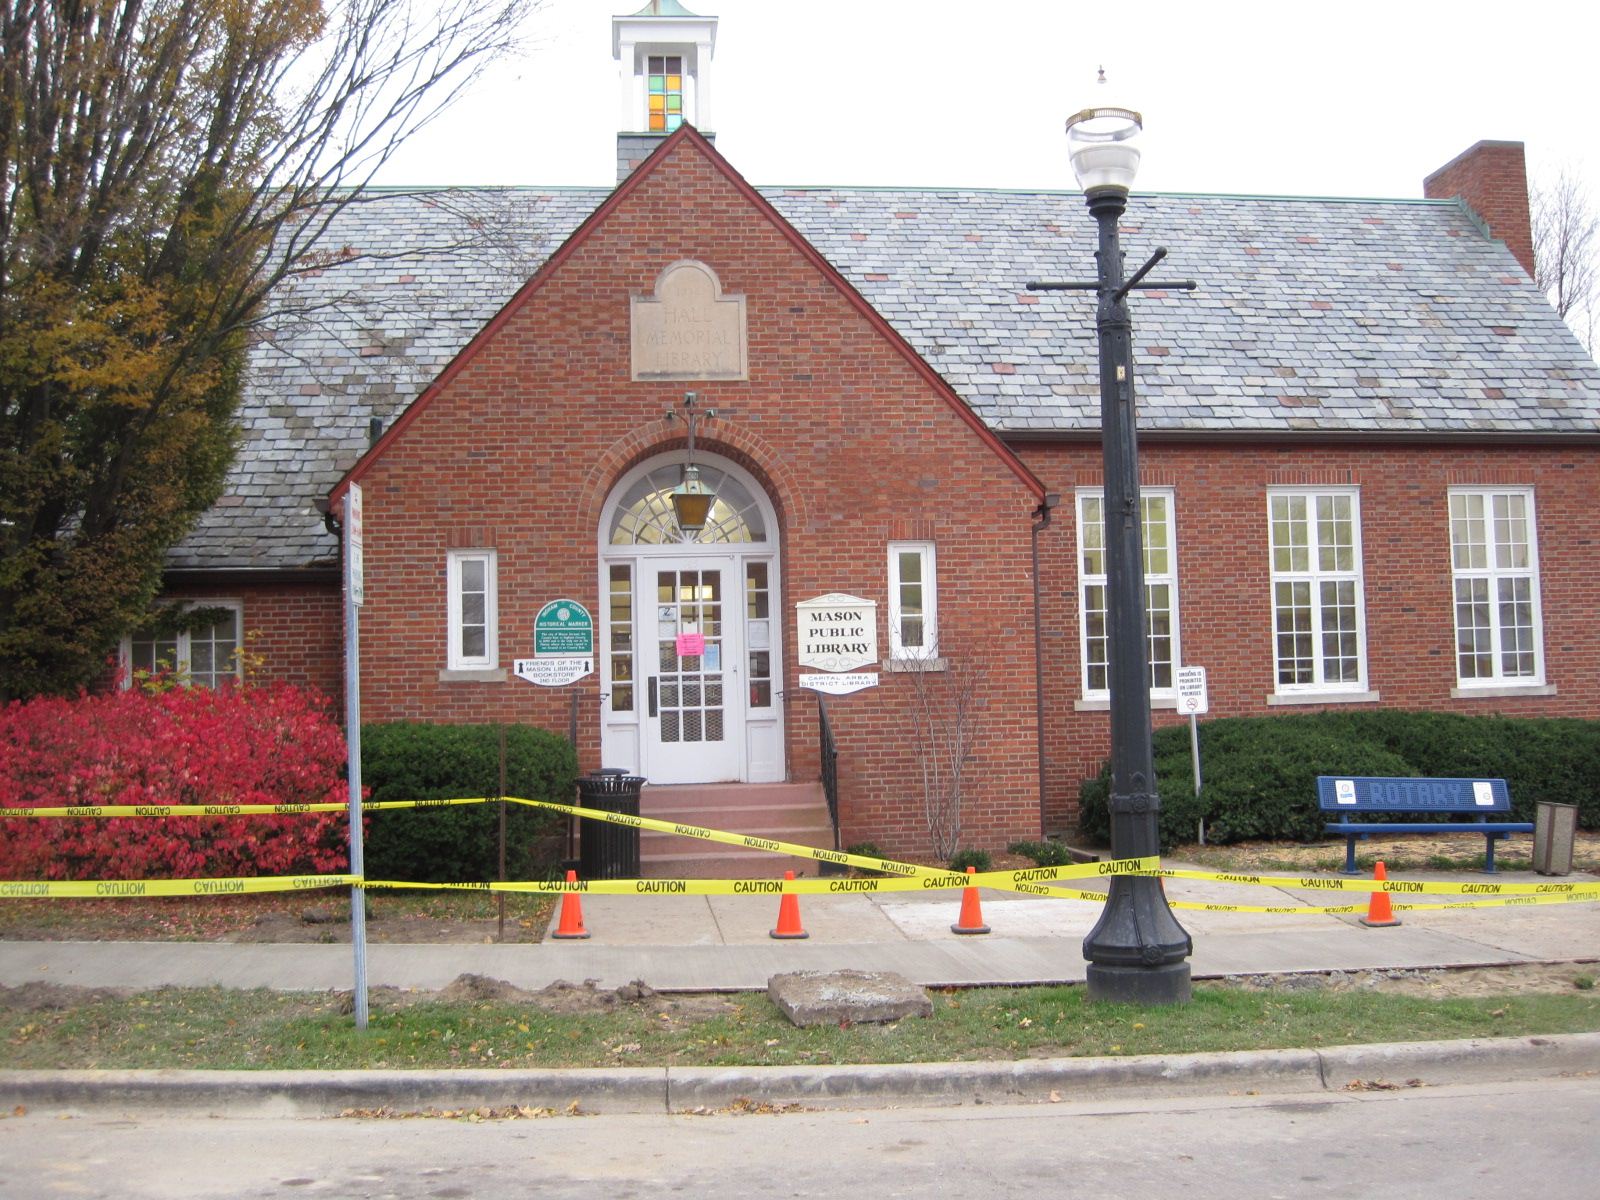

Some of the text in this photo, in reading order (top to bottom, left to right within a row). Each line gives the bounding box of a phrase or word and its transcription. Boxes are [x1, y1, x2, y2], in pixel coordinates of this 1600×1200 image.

[646, 329, 731, 345] MEMORIAL
[656, 352, 723, 368] LIBRARY
[569, 603, 586, 617] COUNTY
[811, 611, 862, 622] MASON
[809, 627, 864, 638] PUBLIC
[806, 643, 871, 655] LIBRARY
[1369, 783, 1461, 804] ROTARY
[67, 807, 102, 816] CAUTION
[135, 807, 171, 816] CAUTION
[205, 806, 241, 815] CAUTION
[274, 804, 311, 813] CAUTION
[606, 813, 642, 826] CAUTION
[675, 825, 711, 838] CAUTION
[744, 837, 780, 850] CAUTION
[812, 849, 848, 863] CAUTION
[881, 861, 916, 875] CAUTION
[539, 881, 588, 892] CAUTION
[636, 881, 686, 893] CAUTION
[734, 881, 783, 893] CAUTION
[830, 880, 878, 892] CAUTION
[923, 875, 970, 889] CAUTION
[1013, 868, 1058, 882] CAUTION
[1098, 860, 1141, 875] CAUTION
[1015, 883, 1049, 895] CAUTION
[1300, 878, 1343, 889] CAUTION
[1382, 881, 1425, 892] CAUTION
[1461, 884, 1502, 894] CAUTION
[1535, 884, 1575, 893] CAUTION
[1323, 906, 1354, 914] CAUTION
